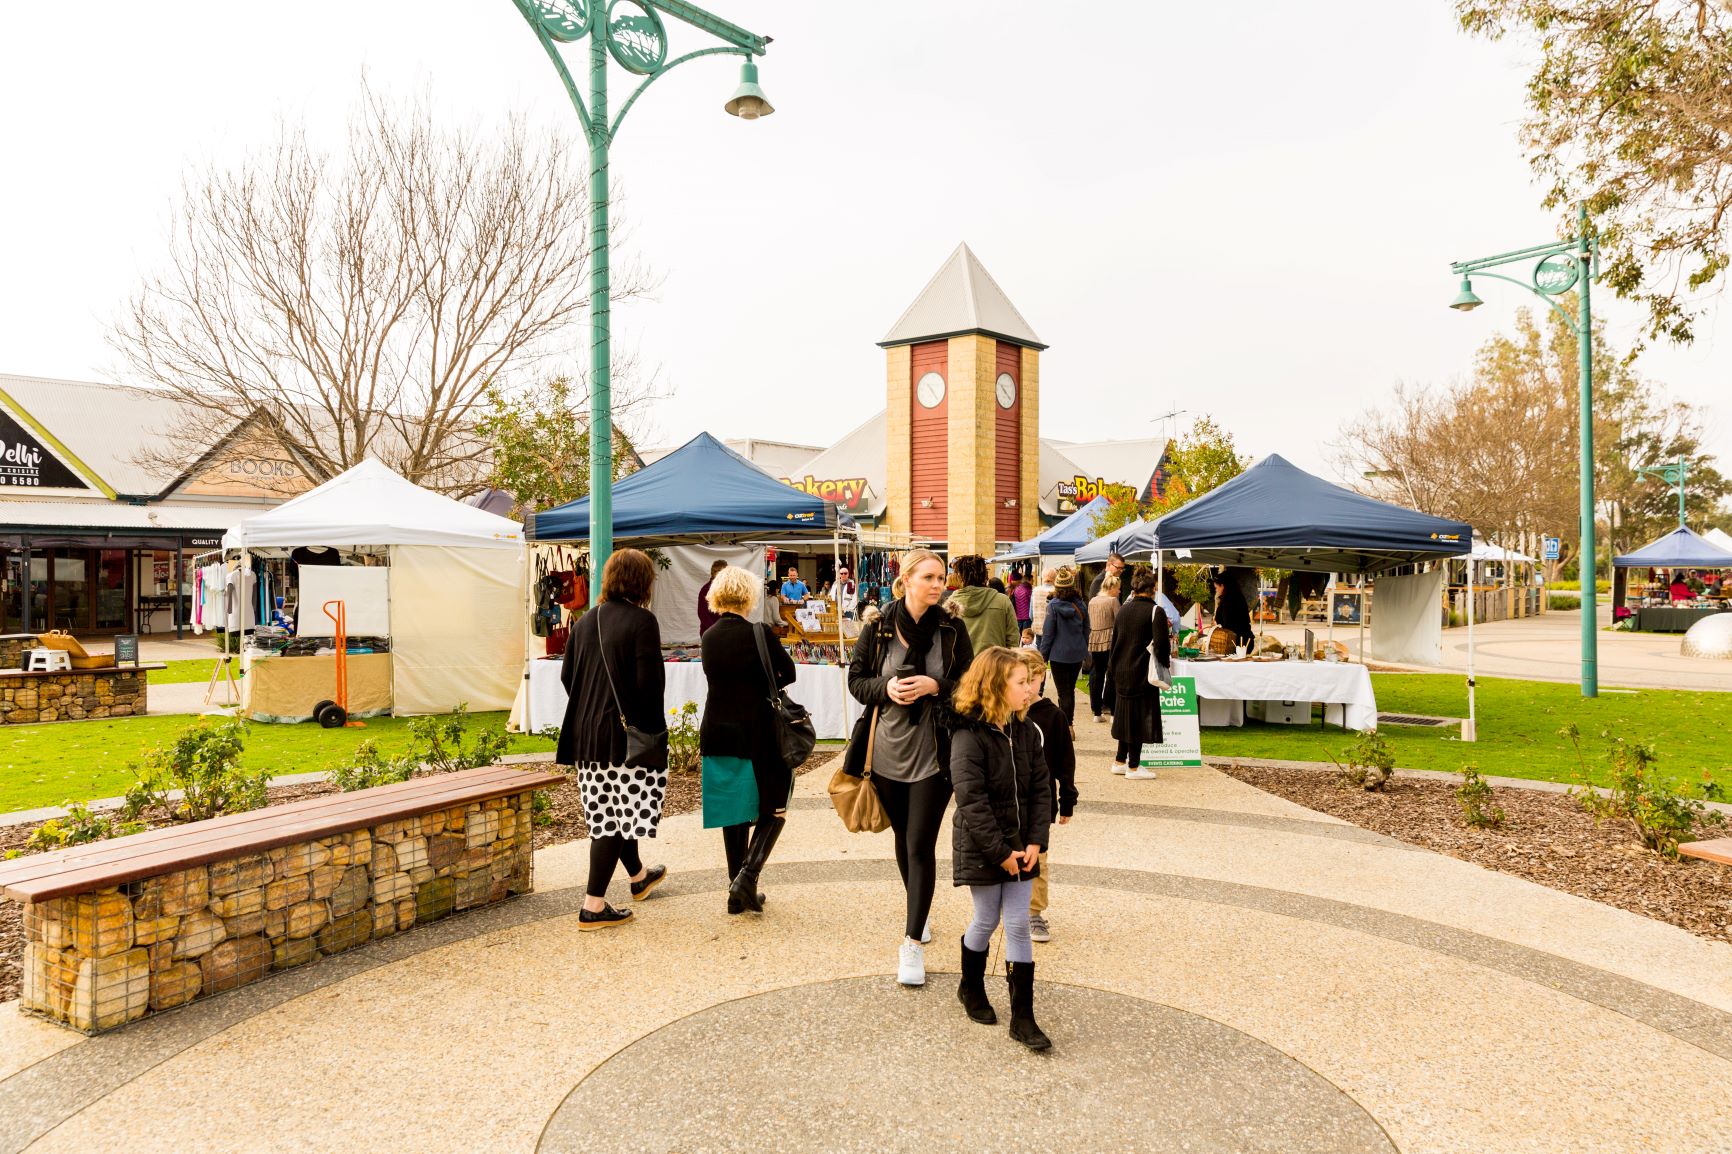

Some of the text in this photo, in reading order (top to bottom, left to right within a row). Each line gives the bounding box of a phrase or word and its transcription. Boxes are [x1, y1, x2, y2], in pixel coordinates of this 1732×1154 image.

[231, 459, 295, 476] BOOKS
[12, 477, 39, 486] 5580
[779, 475, 867, 509] kery
[1059, 476, 1136, 505] Tas's Baky
[1159, 695, 1186, 707] Pate
